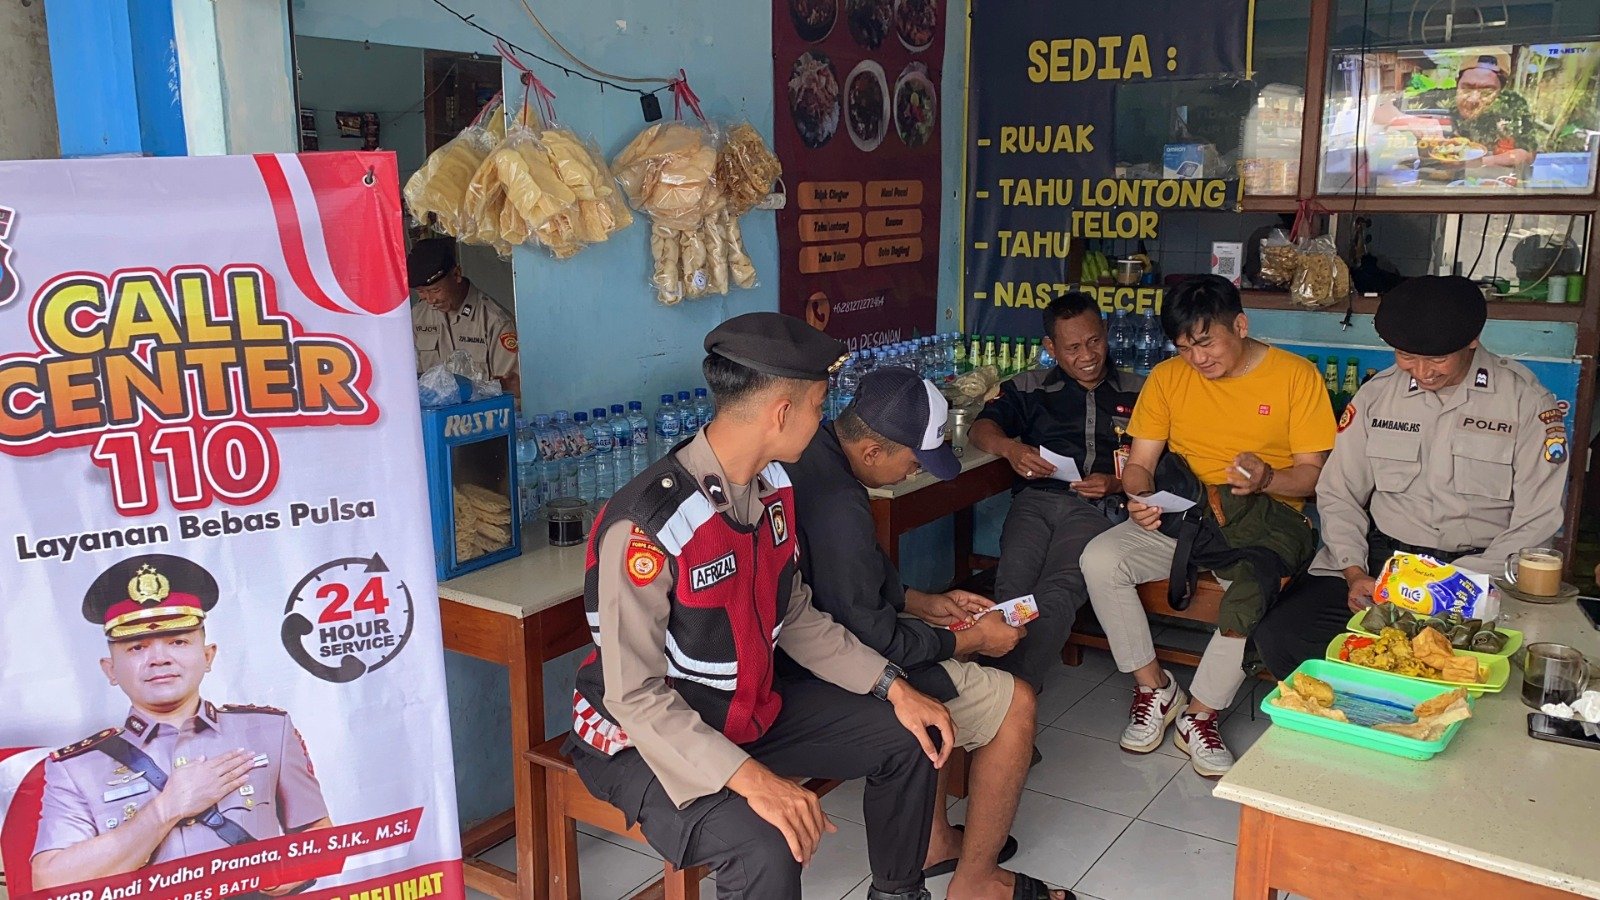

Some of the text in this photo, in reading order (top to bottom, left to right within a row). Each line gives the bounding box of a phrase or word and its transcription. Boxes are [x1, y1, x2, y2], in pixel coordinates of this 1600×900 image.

[1027, 34, 1153, 83] SEDIA
[1000, 124, 1094, 154] RUJAK
[999, 178, 1073, 207] TAHU
[1081, 179, 1226, 208] LONTONG
[998, 230, 1070, 258] TAHU
[1072, 210, 1159, 239] TELOR
[40, 272, 287, 357] CALL
[0, 341, 364, 438] CENTER
[1463, 417, 1512, 433] POLRI
[94, 421, 271, 509] 110
[17, 498, 376, 560] Layanan Bebas Pulsa
[696, 557, 736, 587] AFRIZAL
[314, 576, 390, 625] 24
[319, 618, 391, 644] HOUR
[319, 634, 395, 659] SERVICE
[100, 878, 142, 900] Andi
[148, 866, 204, 892] Yudha
[219, 876, 260, 896] BATU
